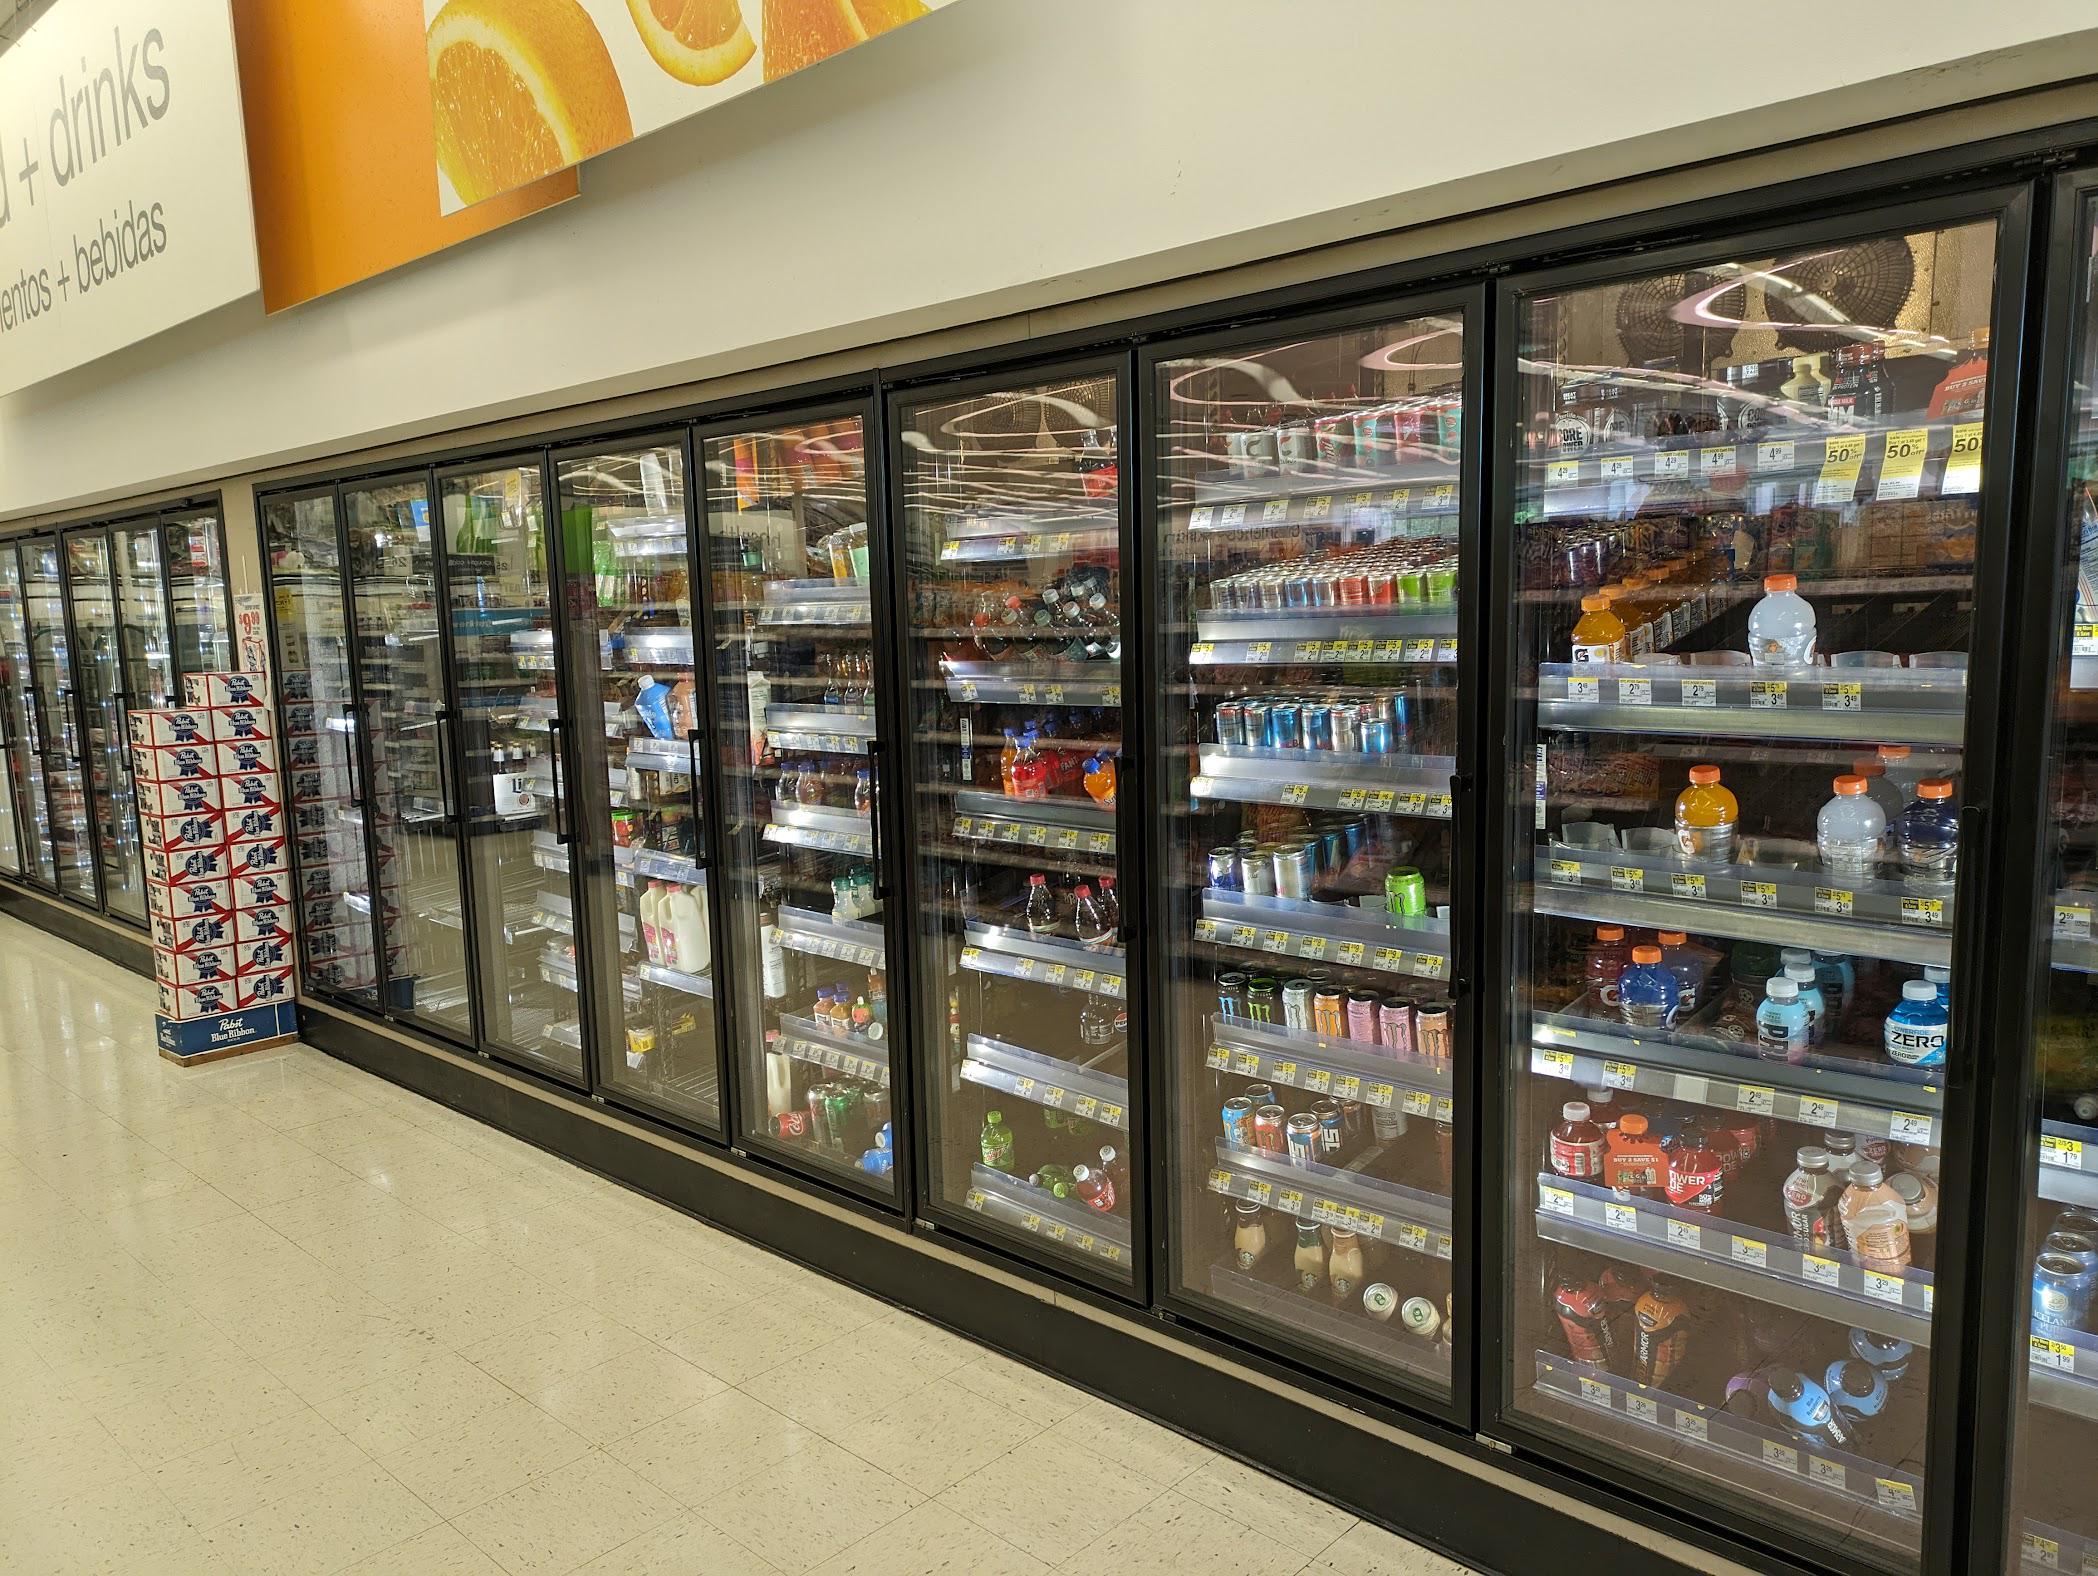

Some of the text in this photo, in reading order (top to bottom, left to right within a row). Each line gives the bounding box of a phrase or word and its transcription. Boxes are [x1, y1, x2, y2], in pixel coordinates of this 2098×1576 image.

[49, 26, 171, 188] drinks
[73, 200, 168, 295] bebidas
[1887, 444, 1911, 459] 50
[1954, 437, 1978, 452] 50
[1827, 448, 1849, 463] 50
[1060, 756, 1079, 771] FANT
[2060, 912, 2075, 924] 259
[219, 1018, 243, 1031] Pabst
[211, 1027, 255, 1043] Blue Ribbon
[1891, 1031, 1944, 1048] ZERO
[2063, 1152, 2078, 1163] 179
[2056, 1354, 2071, 1366] 199
